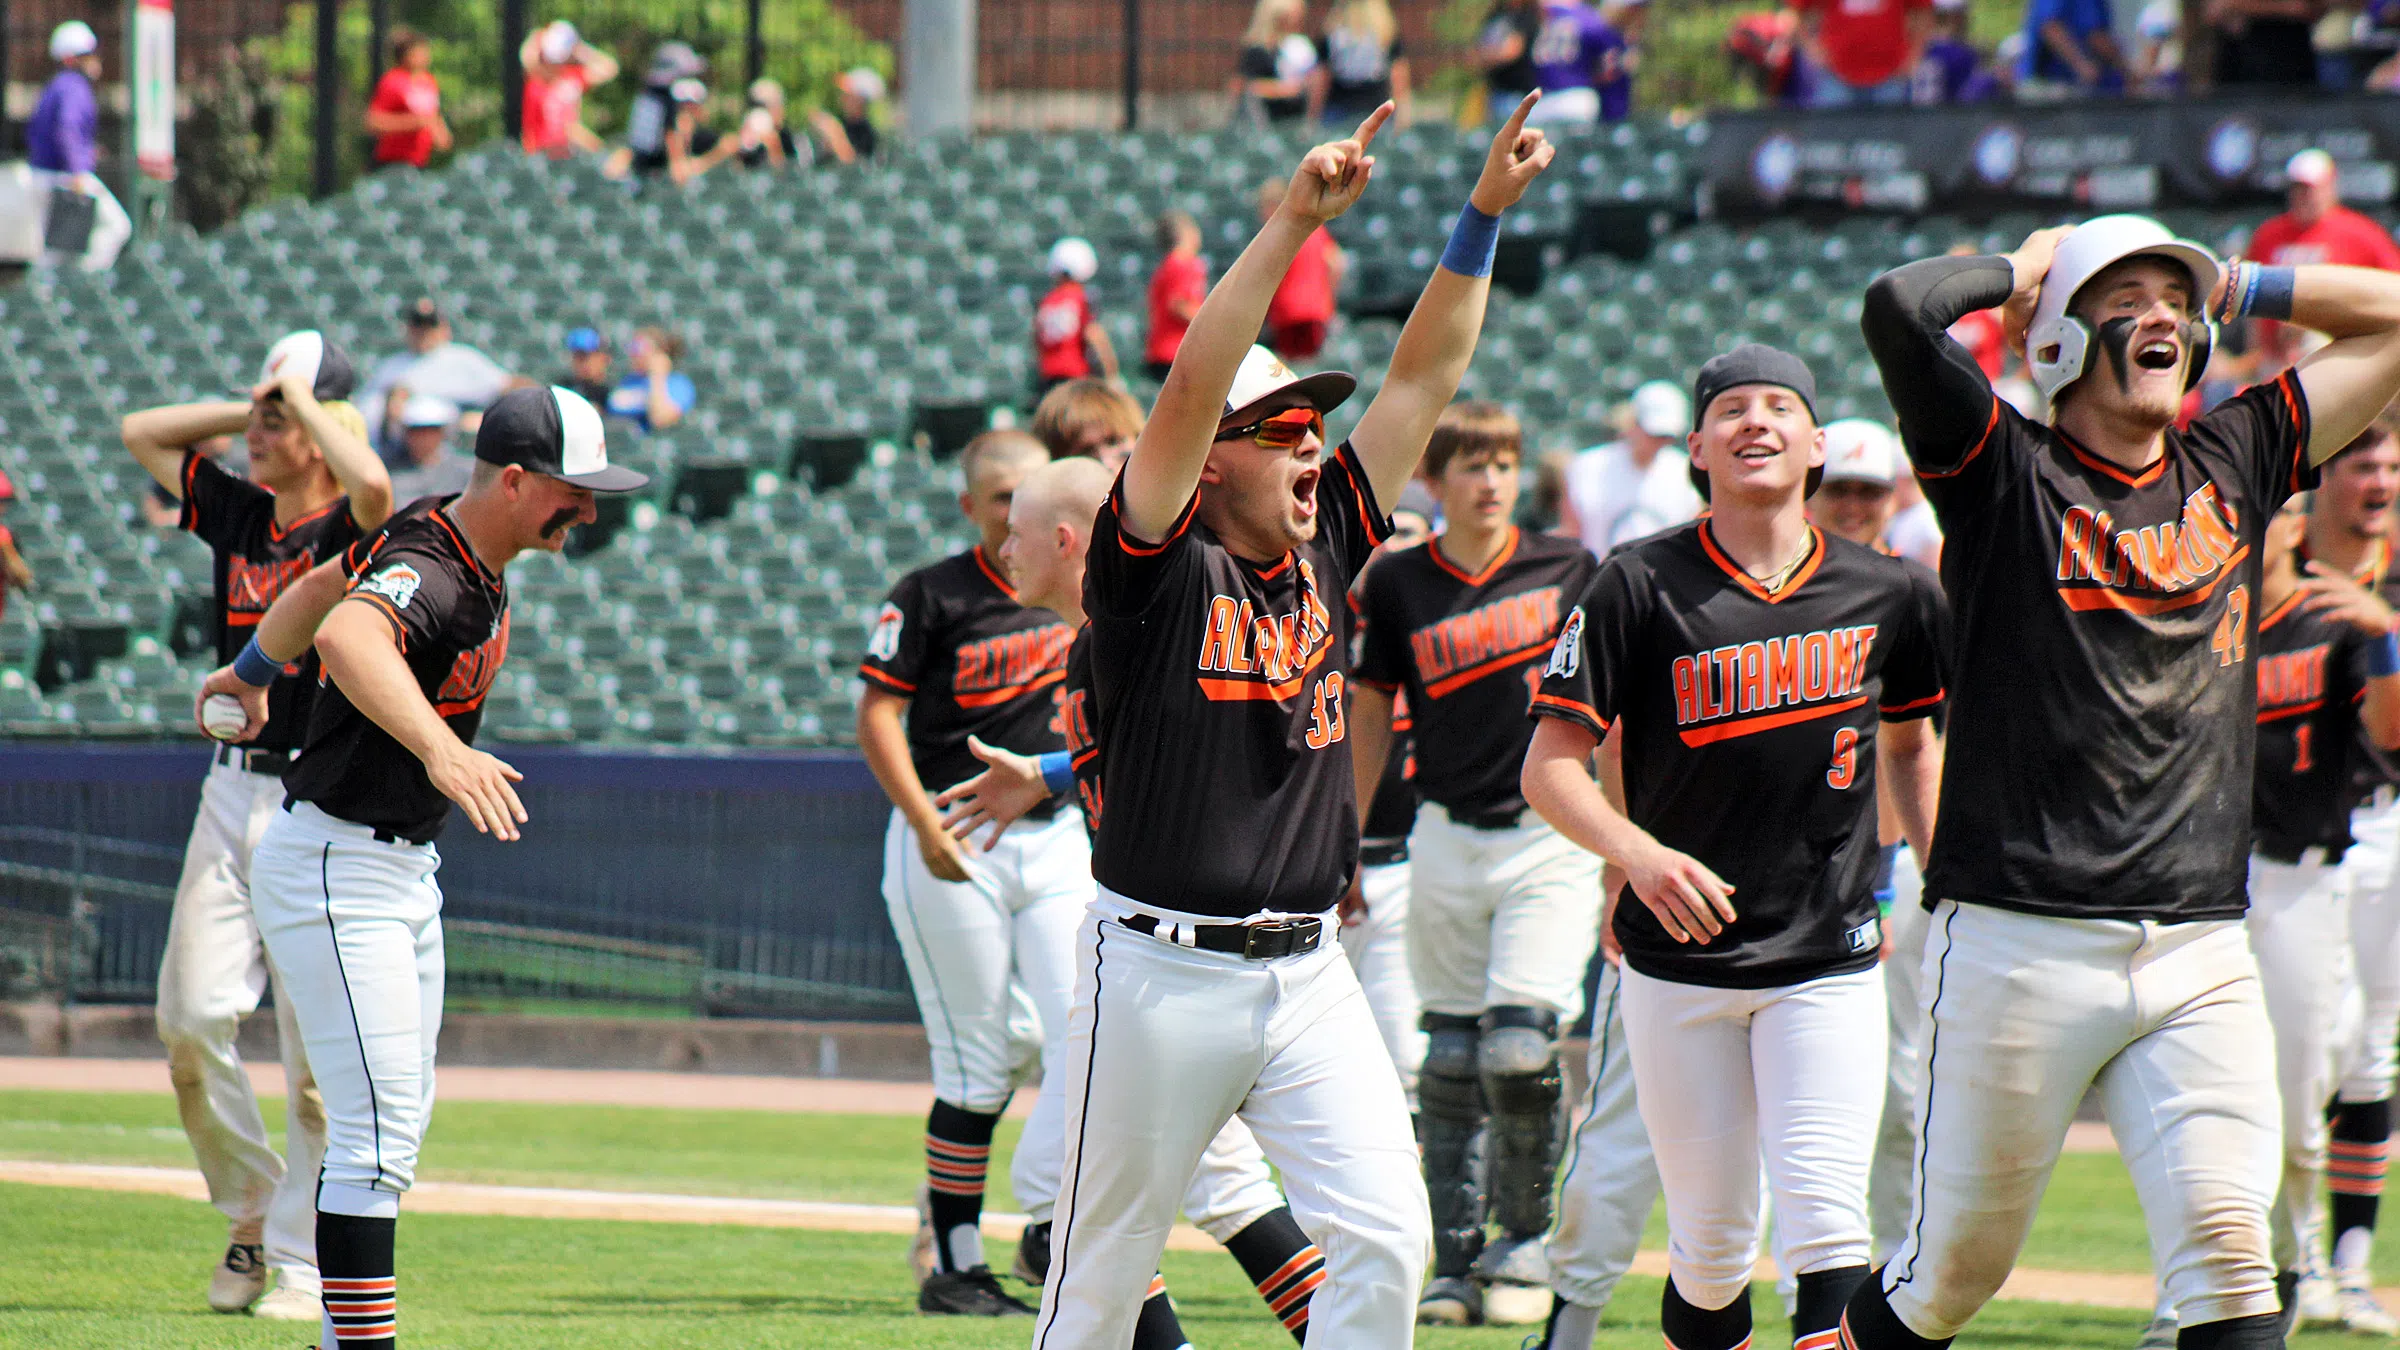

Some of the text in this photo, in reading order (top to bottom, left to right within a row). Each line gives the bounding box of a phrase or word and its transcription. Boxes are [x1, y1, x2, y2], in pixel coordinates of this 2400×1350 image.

[1198, 558, 1330, 682] ALAMONT
[1410, 583, 1563, 683] ALTAMONT
[2210, 583, 2250, 668] 42
[1305, 670, 1346, 750] 33
[1671, 624, 1879, 725] ALTAMONT
[1826, 726, 1860, 790] 9
[2292, 722, 2315, 773] 1
